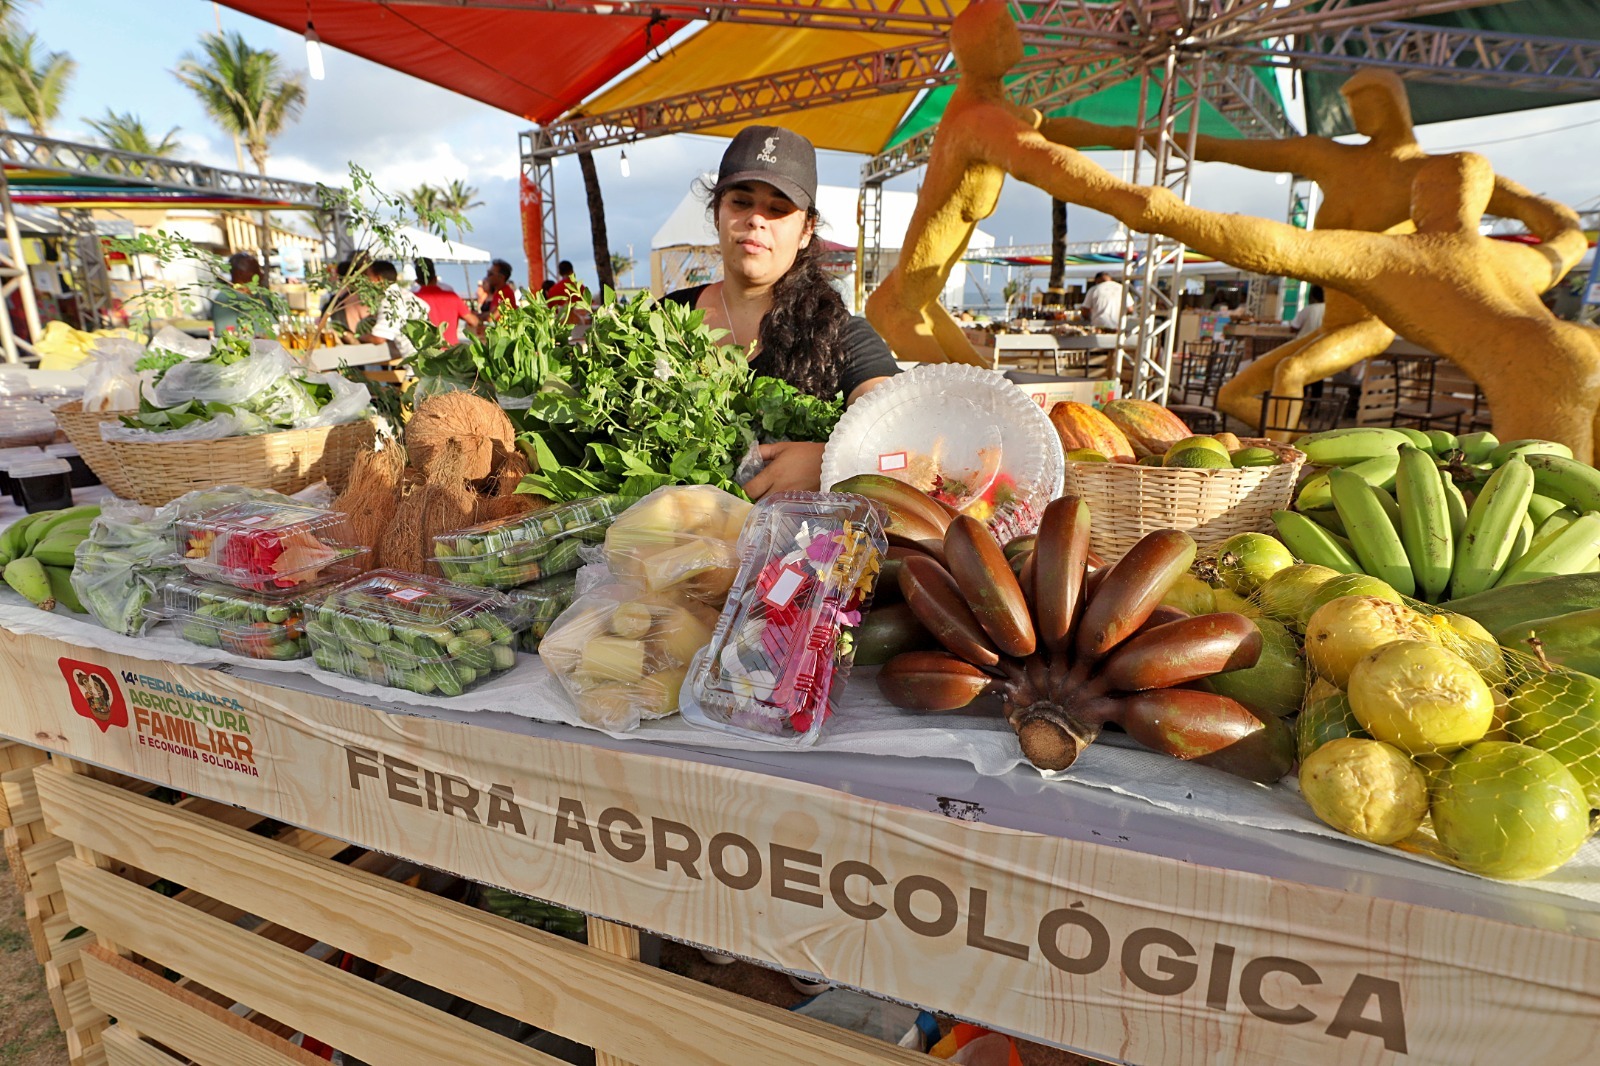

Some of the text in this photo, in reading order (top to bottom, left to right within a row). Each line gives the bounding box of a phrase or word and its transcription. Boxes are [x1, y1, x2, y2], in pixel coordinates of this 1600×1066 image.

[756, 153, 777, 164] POLO
[139, 674, 176, 695] FEIRA
[129, 688, 251, 735] AGRICULTURA
[133, 706, 256, 765] FAMILIAR
[139, 734, 146, 745] E
[147, 736, 199, 760] ECONOMIA
[345, 744, 1409, 1055] FEIRA AGROECOLÓGICA
